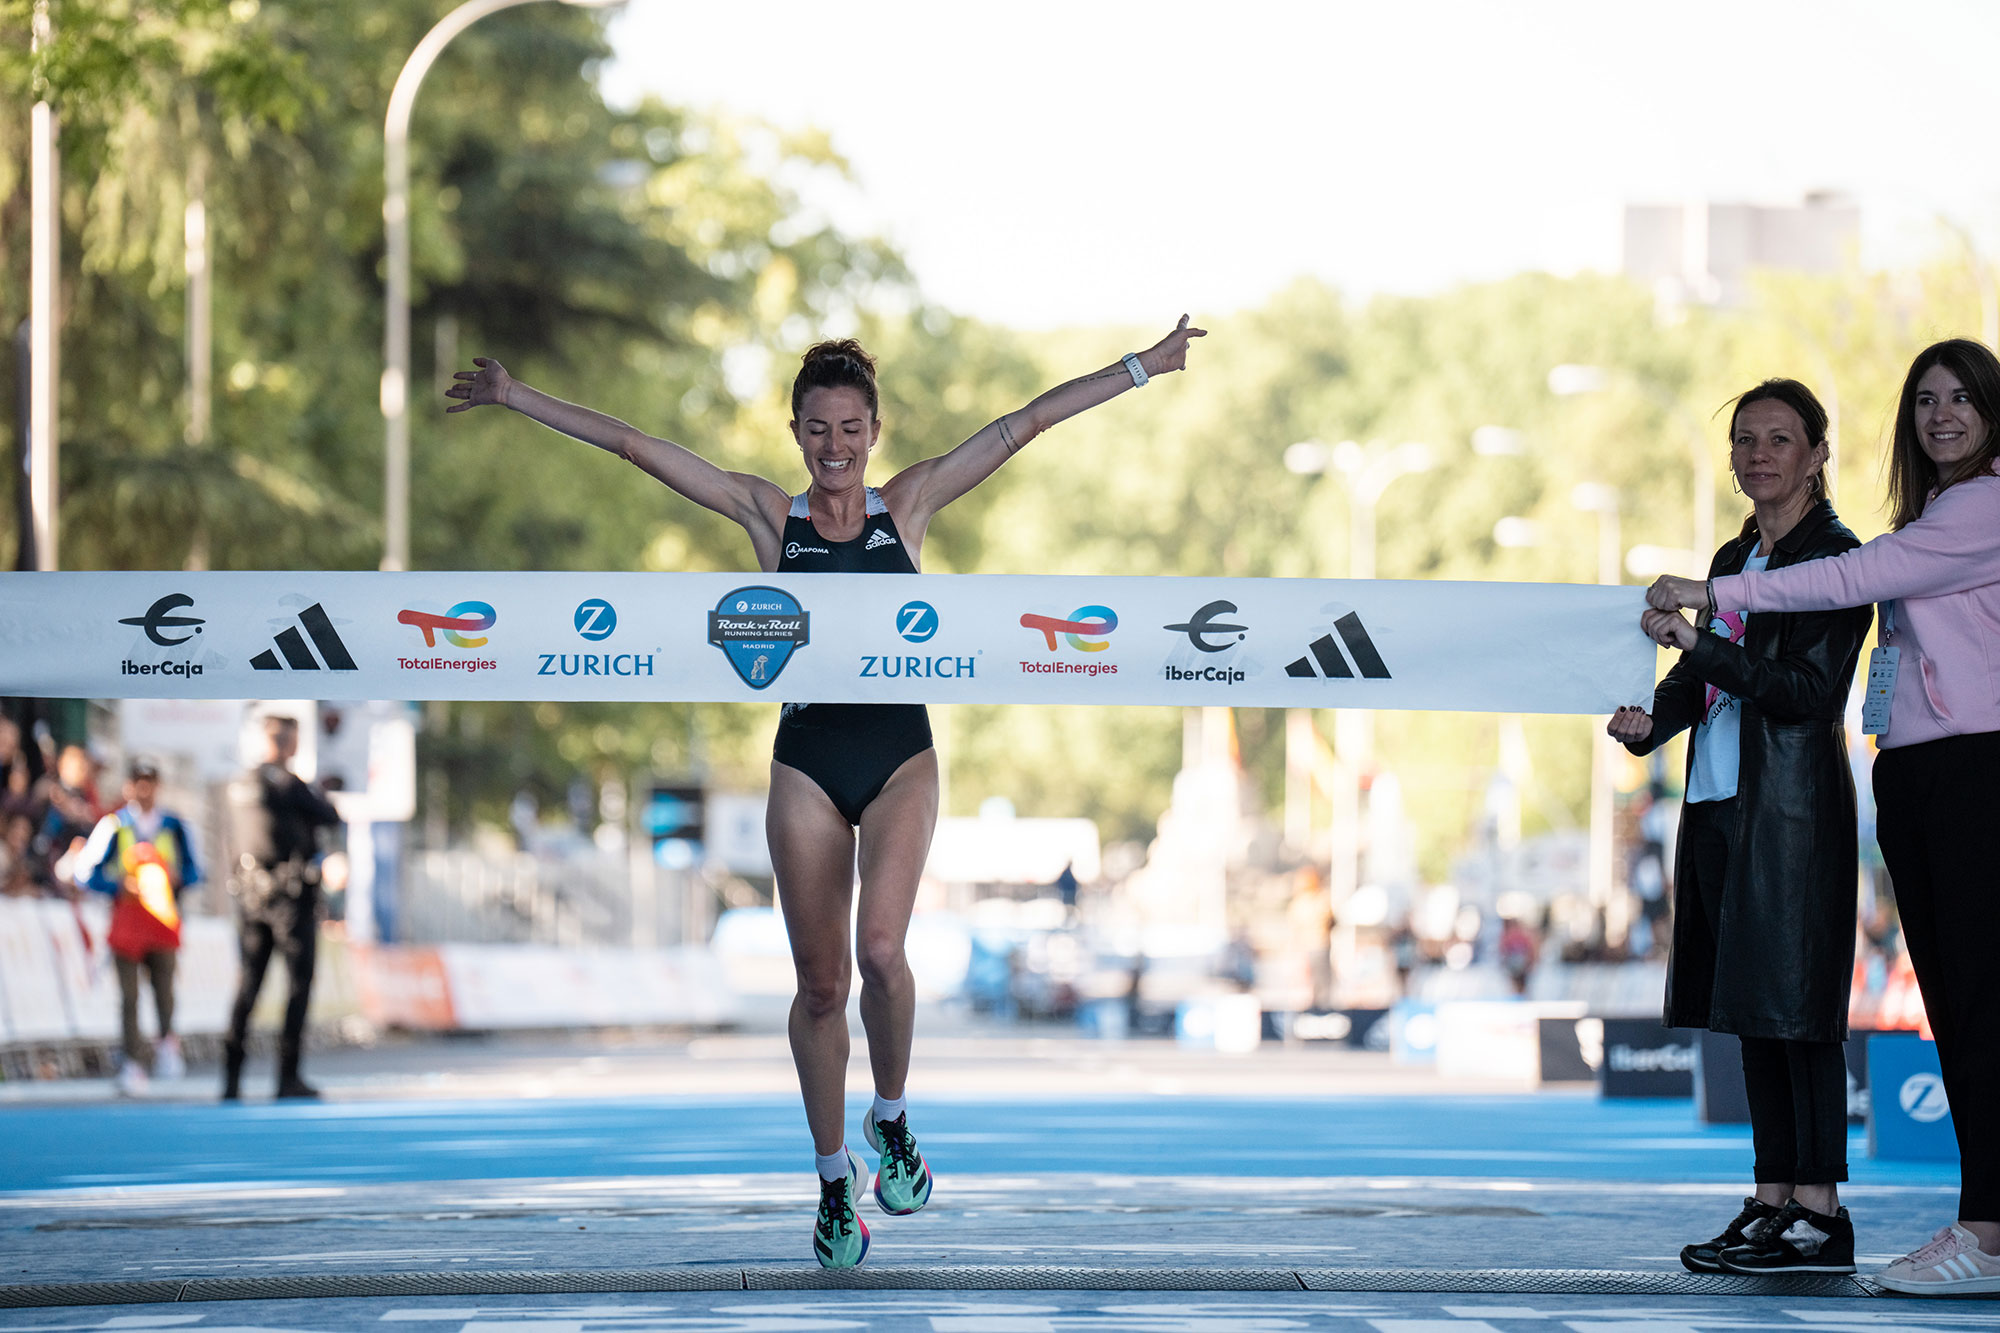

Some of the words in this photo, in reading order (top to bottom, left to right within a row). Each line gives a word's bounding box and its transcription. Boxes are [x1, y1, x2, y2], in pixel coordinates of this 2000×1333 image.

[798, 547, 829, 555] MAPOMA
[865, 536, 897, 551] adidas
[121, 659, 203, 679] iberCaja
[397, 657, 497, 673] TotalEnergies
[538, 654, 654, 676] ZURICH
[859, 656, 975, 679] ZURICH
[1019, 661, 1118, 677] TotalEnergies
[1165, 665, 1245, 685] iberCaja
